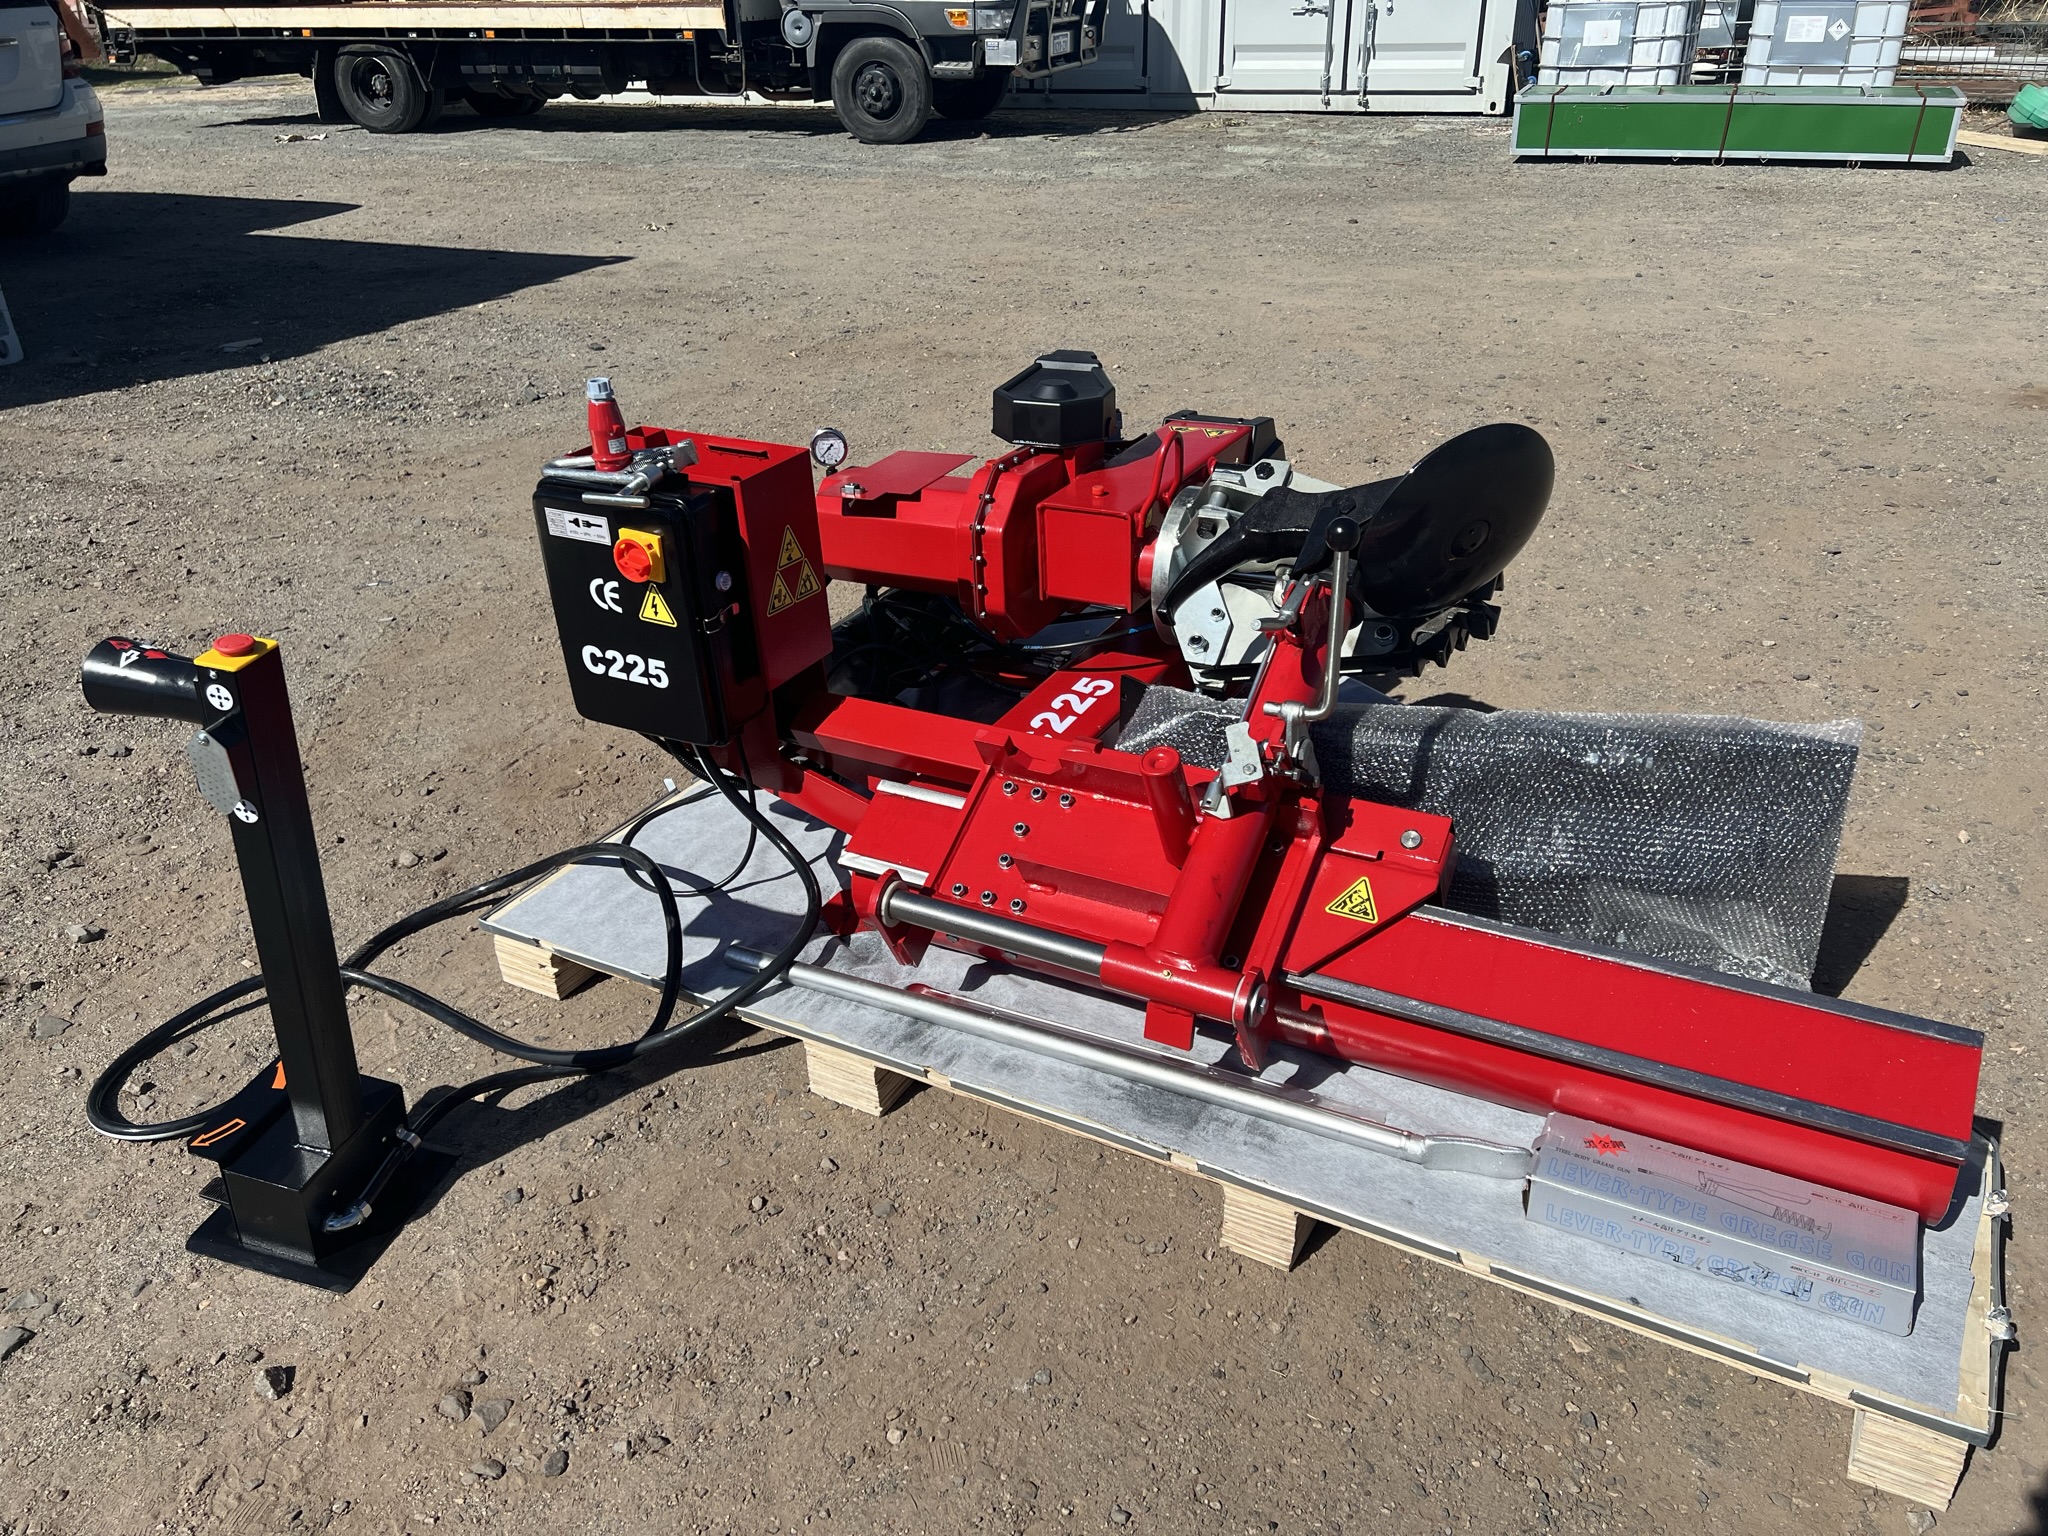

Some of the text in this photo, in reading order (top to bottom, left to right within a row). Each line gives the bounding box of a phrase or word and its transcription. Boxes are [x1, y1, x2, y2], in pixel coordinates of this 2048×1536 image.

[589, 577, 623, 614] CE
[582, 644, 669, 689] C225
[1025, 677, 1115, 739] 225
[1555, 1146, 1631, 1175] STEEL-BODY GREASE GUN
[1547, 1157, 1912, 1284] LEVER-TYPE GREASE GUN
[1545, 1203, 1886, 1325] LEVER-TYPE GREASE GUN
